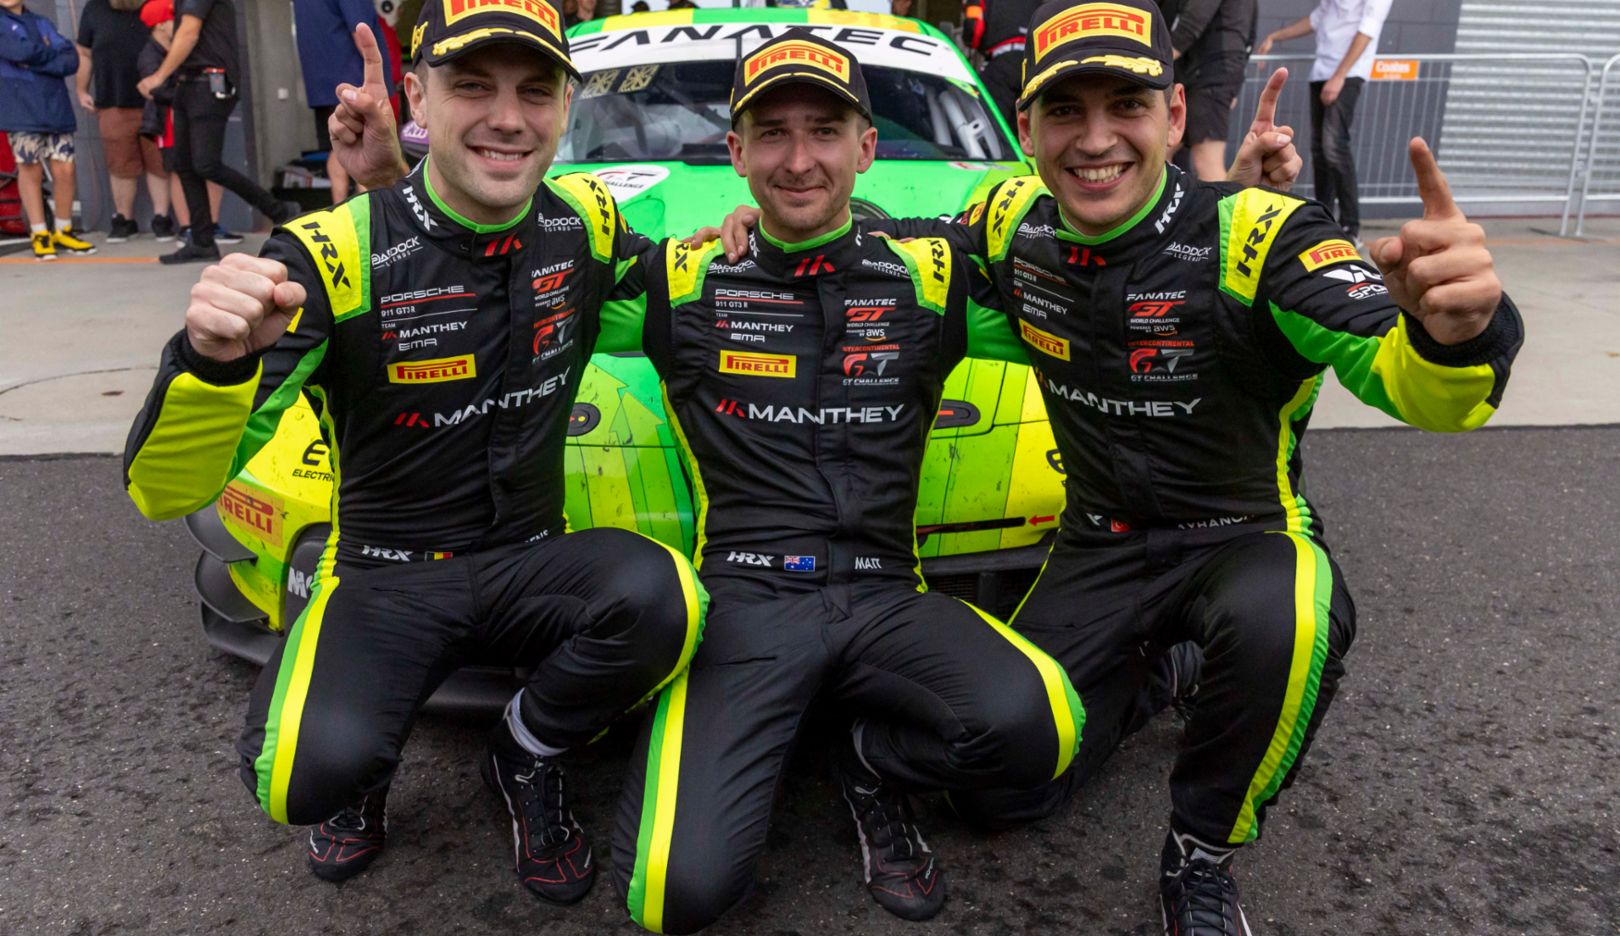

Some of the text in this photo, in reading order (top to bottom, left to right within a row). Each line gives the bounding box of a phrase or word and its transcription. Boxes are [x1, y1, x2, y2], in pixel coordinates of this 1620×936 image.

[1038, 9, 1144, 54] PIRELLI
[749, 44, 843, 77] PIRELLI
[402, 185, 439, 231] HRX
[1236, 204, 1282, 278] HRX
[302, 222, 351, 289] HRX
[675, 244, 688, 273] RX
[1308, 243, 1358, 265] PIRE
[381, 285, 465, 304] PORSCHE
[715, 288, 794, 300] PORSCHE
[844, 298, 896, 307] FANATEC
[1023, 292, 1068, 315] MANTHEY
[1126, 290, 1186, 301] FANATEC
[846, 307, 896, 322] GT
[1022, 303, 1047, 320] EMA
[1128, 300, 1185, 317] GT
[400, 321, 468, 338] MANTHEY
[731, 321, 794, 332] MANTHEY
[866, 328, 885, 337] aws
[399, 338, 438, 351] EMA
[731, 333, 765, 342] EMA
[1023, 324, 1064, 356] PIRELLI
[396, 360, 467, 379] PIRELLI
[726, 355, 789, 374] PIRELLI
[434, 365, 571, 427] MANTHEY
[1048, 379, 1202, 417] MANTHEY
[749, 403, 904, 426] MANTHEY
[220, 485, 274, 534] IRELLI
[362, 545, 413, 562] HRX
[727, 551, 774, 567] HRX
